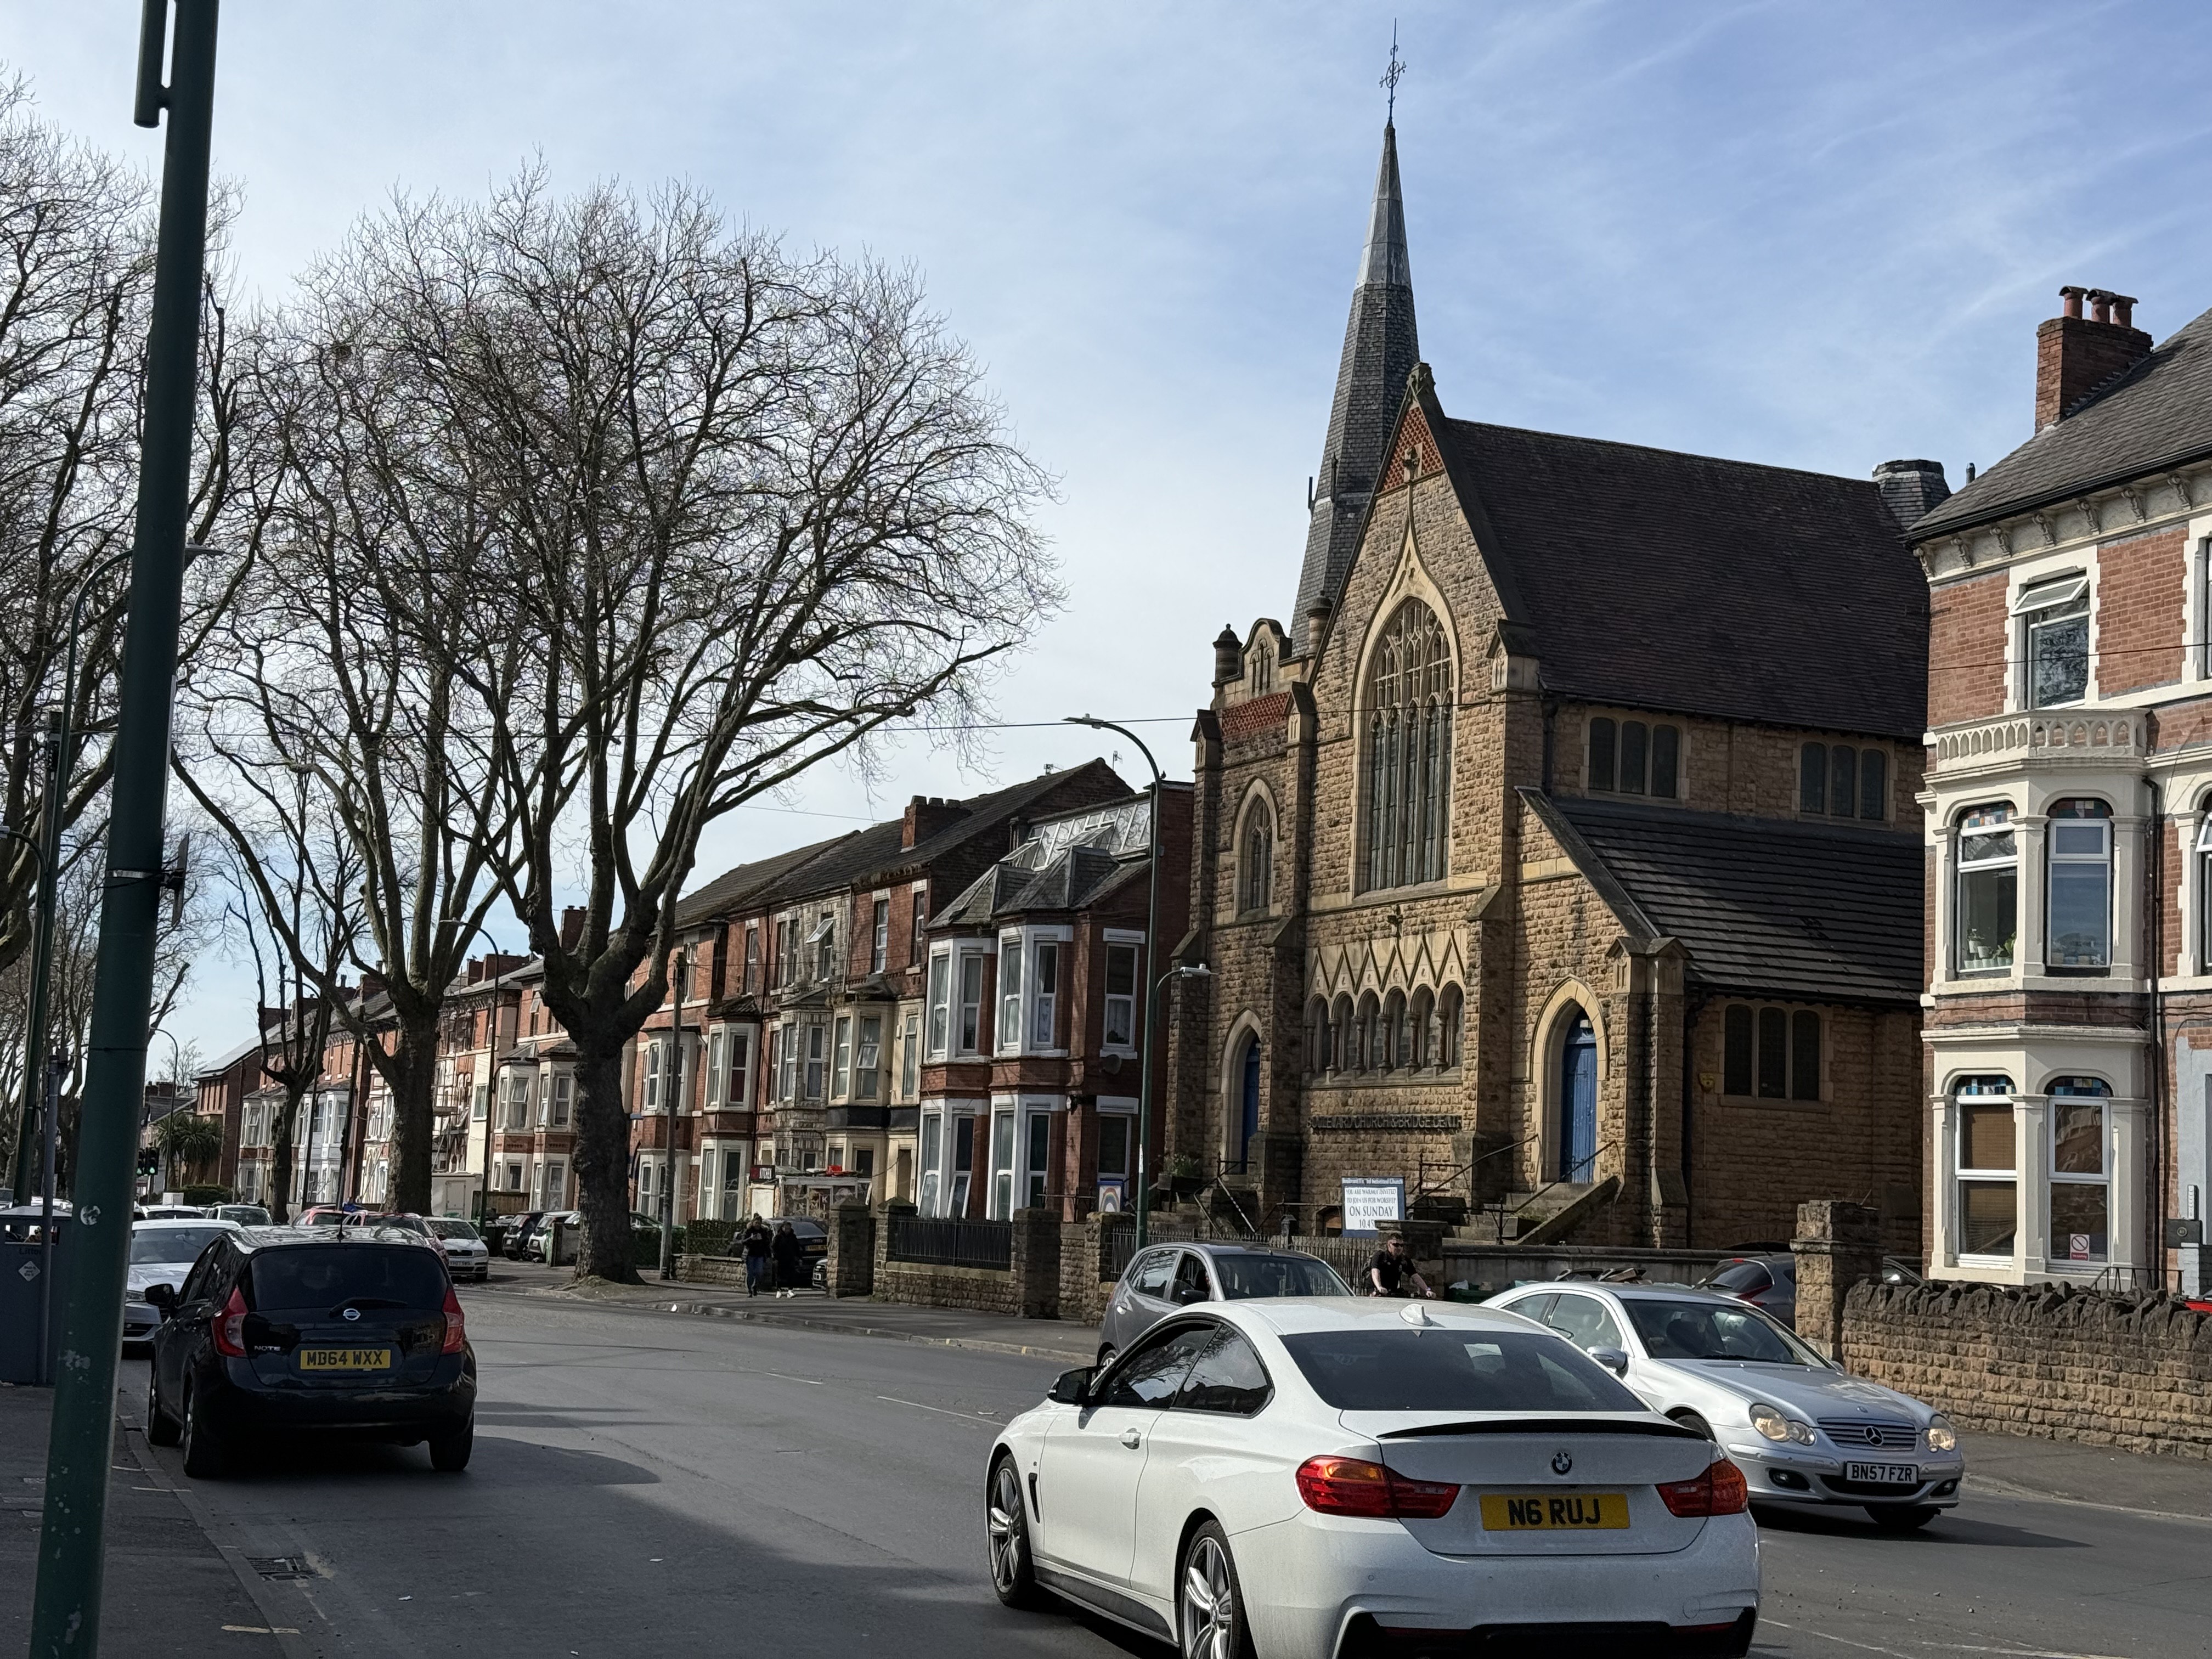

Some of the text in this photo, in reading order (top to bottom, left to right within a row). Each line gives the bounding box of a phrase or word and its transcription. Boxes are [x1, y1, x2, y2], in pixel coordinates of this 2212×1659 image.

[1354, 1115, 1389, 1128] CHURCH
[1398, 1116, 1431, 1128] BRIDGE
[1433, 1116, 1462, 1128] CENTR
[1349, 1206, 1394, 1217] ON SUNDAY
[352, 1351, 383, 1365] WXX
[1851, 1464, 1912, 1481] BN57 FZR
[1507, 1498, 1601, 1526] N6 RUJ
